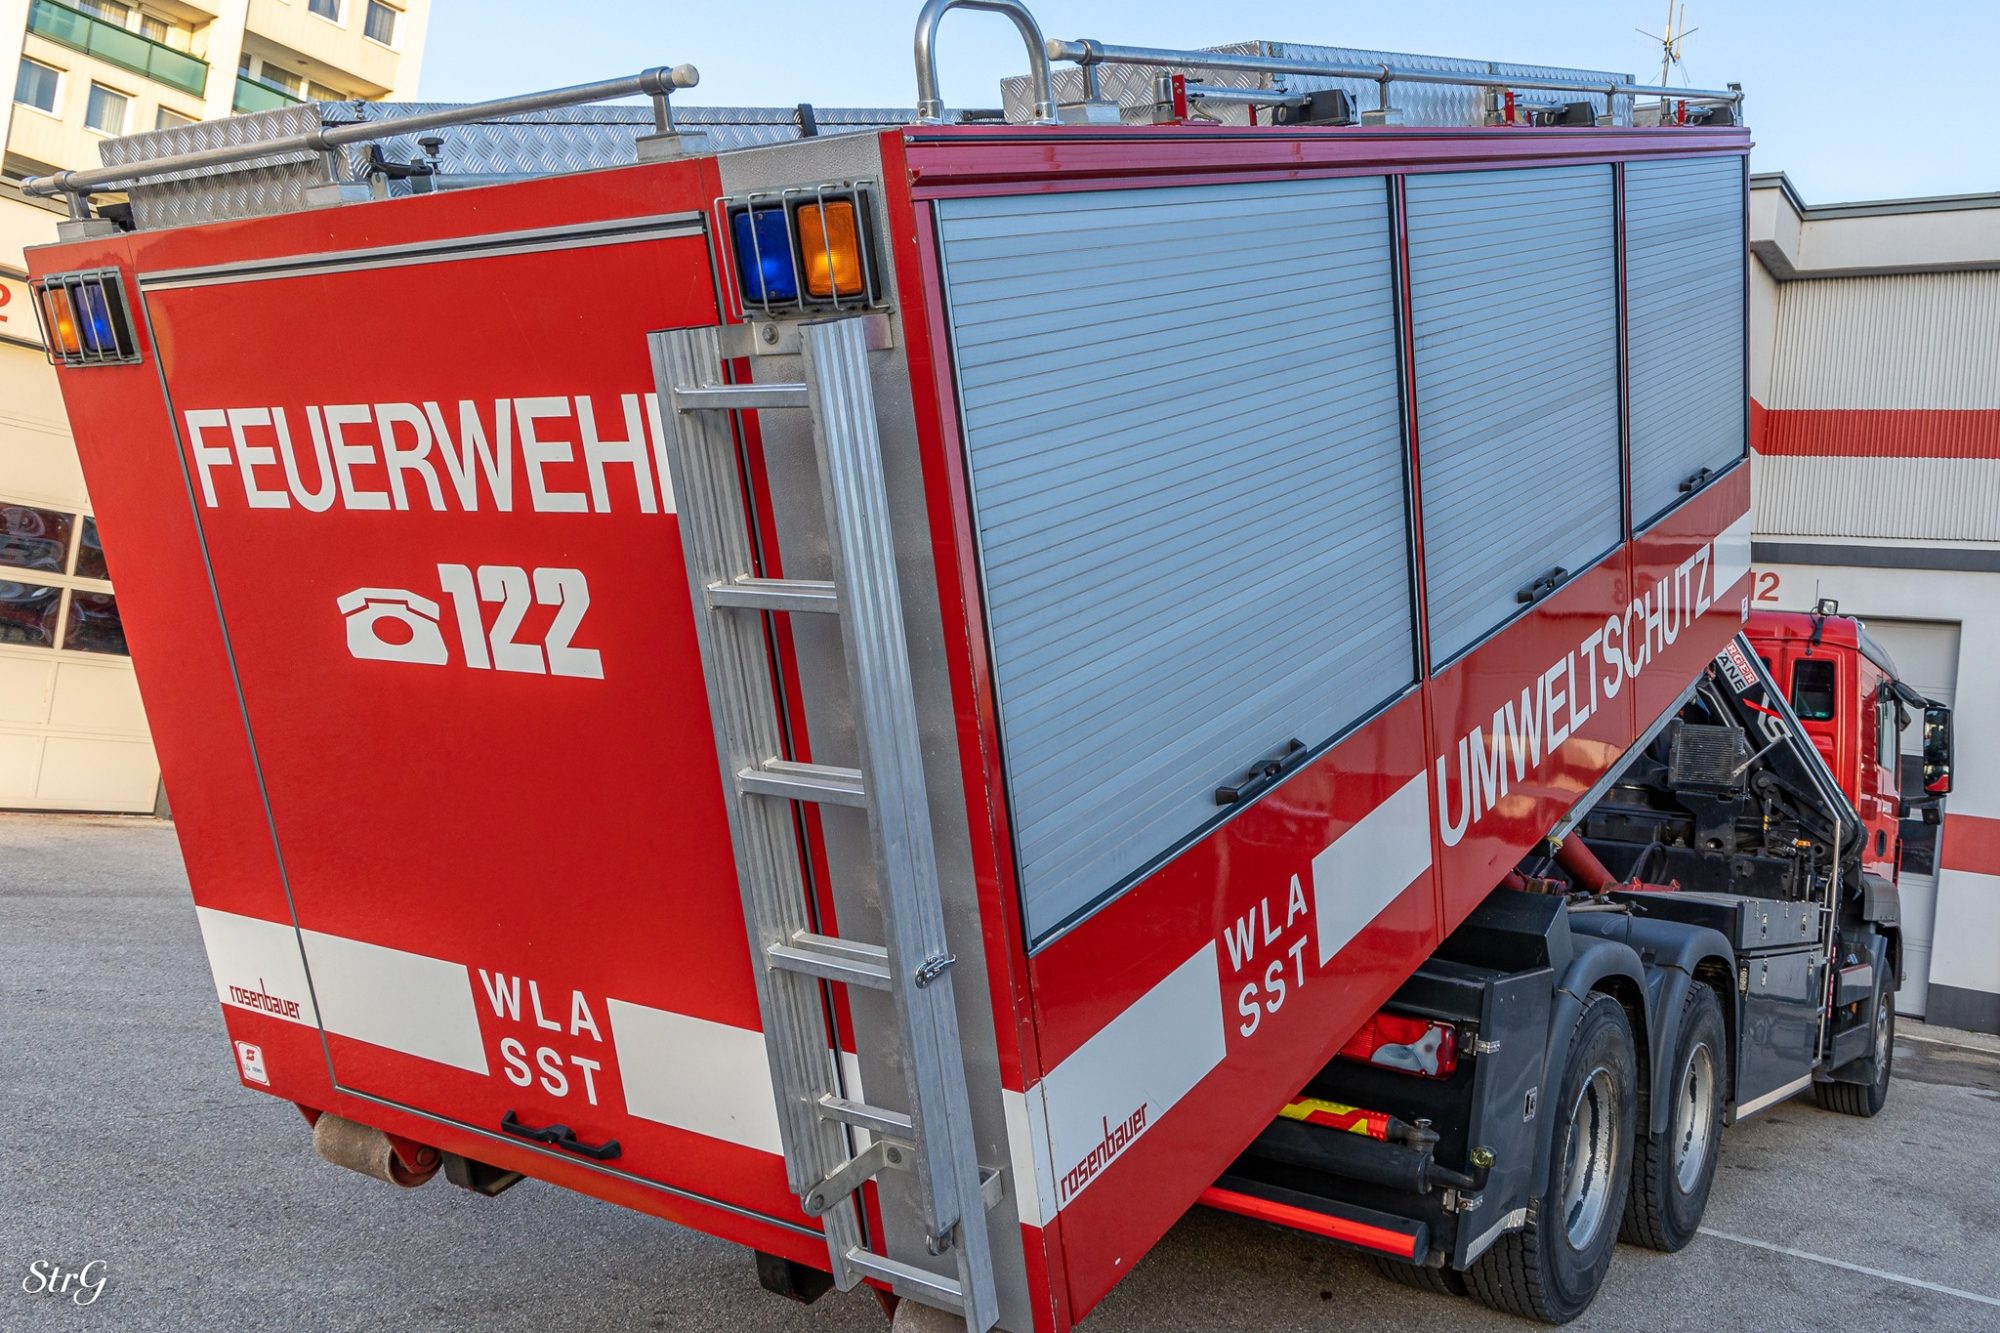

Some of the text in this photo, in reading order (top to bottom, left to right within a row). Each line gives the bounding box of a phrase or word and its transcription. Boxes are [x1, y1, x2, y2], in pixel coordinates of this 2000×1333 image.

[438, 563, 605, 680] 122
[1727, 642, 1758, 684] RGER
[1436, 542, 1711, 847] UMWELTSCHUTZ
[1223, 873, 1308, 972] WLA
[229, 977, 300, 1020] rosenbauer
[478, 968, 603, 1042] WLA
[1238, 935, 1308, 1038] SST
[500, 1037, 601, 1106] SST
[1060, 1102, 1147, 1203] rosenbauer
